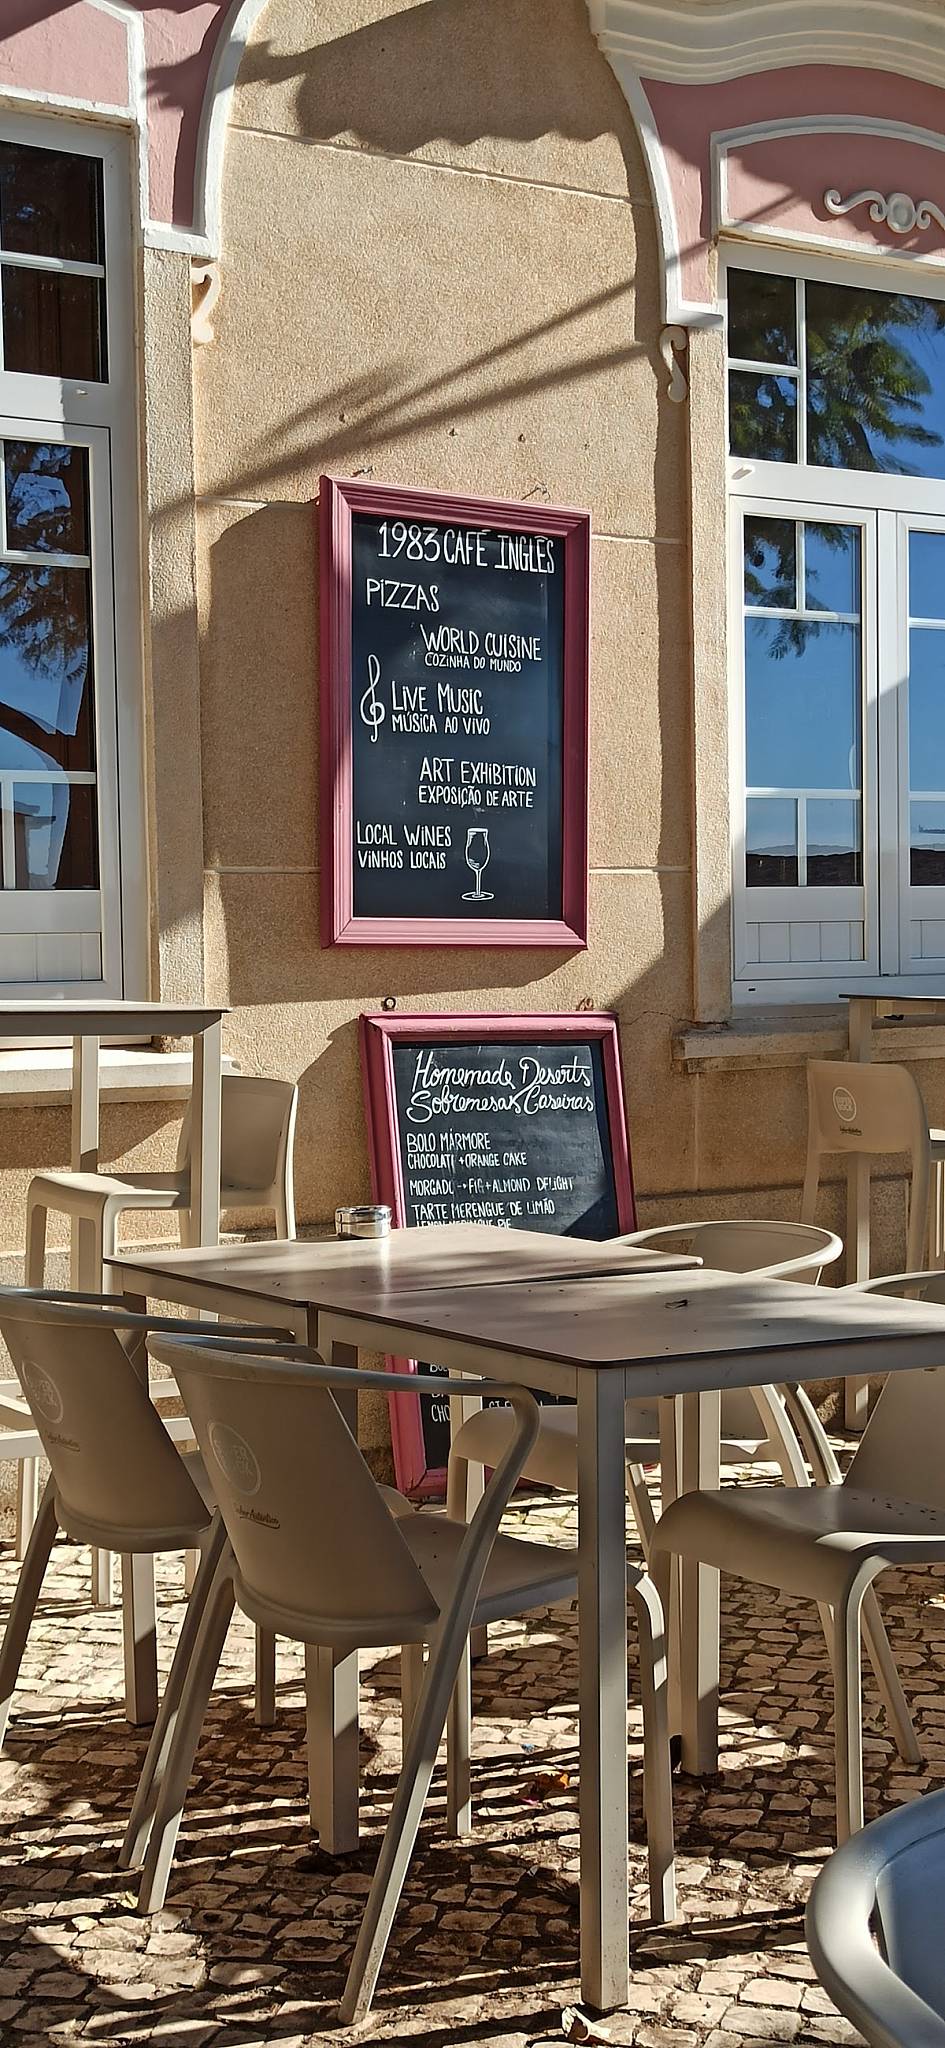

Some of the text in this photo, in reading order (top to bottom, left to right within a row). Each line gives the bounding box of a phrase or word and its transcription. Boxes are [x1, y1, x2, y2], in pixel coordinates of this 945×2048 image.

[378, 522, 555, 573] 1983 CAFÉ INGLÊS
[420, 624, 480, 655] WORLD
[473, 655, 486, 670] DO
[490, 658, 522, 672] MUNDO
[444, 716, 458, 734] AO
[419, 757, 455, 783] ART
[486, 790, 499, 807] DE
[501, 790, 534, 808] ARTE
[356, 821, 398, 846] LOCAL
[412, 1050, 592, 1093] Homemade Deserts
[523, 1085, 595, 1115] Caseiras
[406, 1128, 491, 1153] BOLO MÁRMORE
[503, 1152, 528, 1167] CAKE
[410, 1202, 448, 1221] TARTE
[450, 1201, 505, 1219] MERENGUE
[509, 1201, 523, 1216] DE
